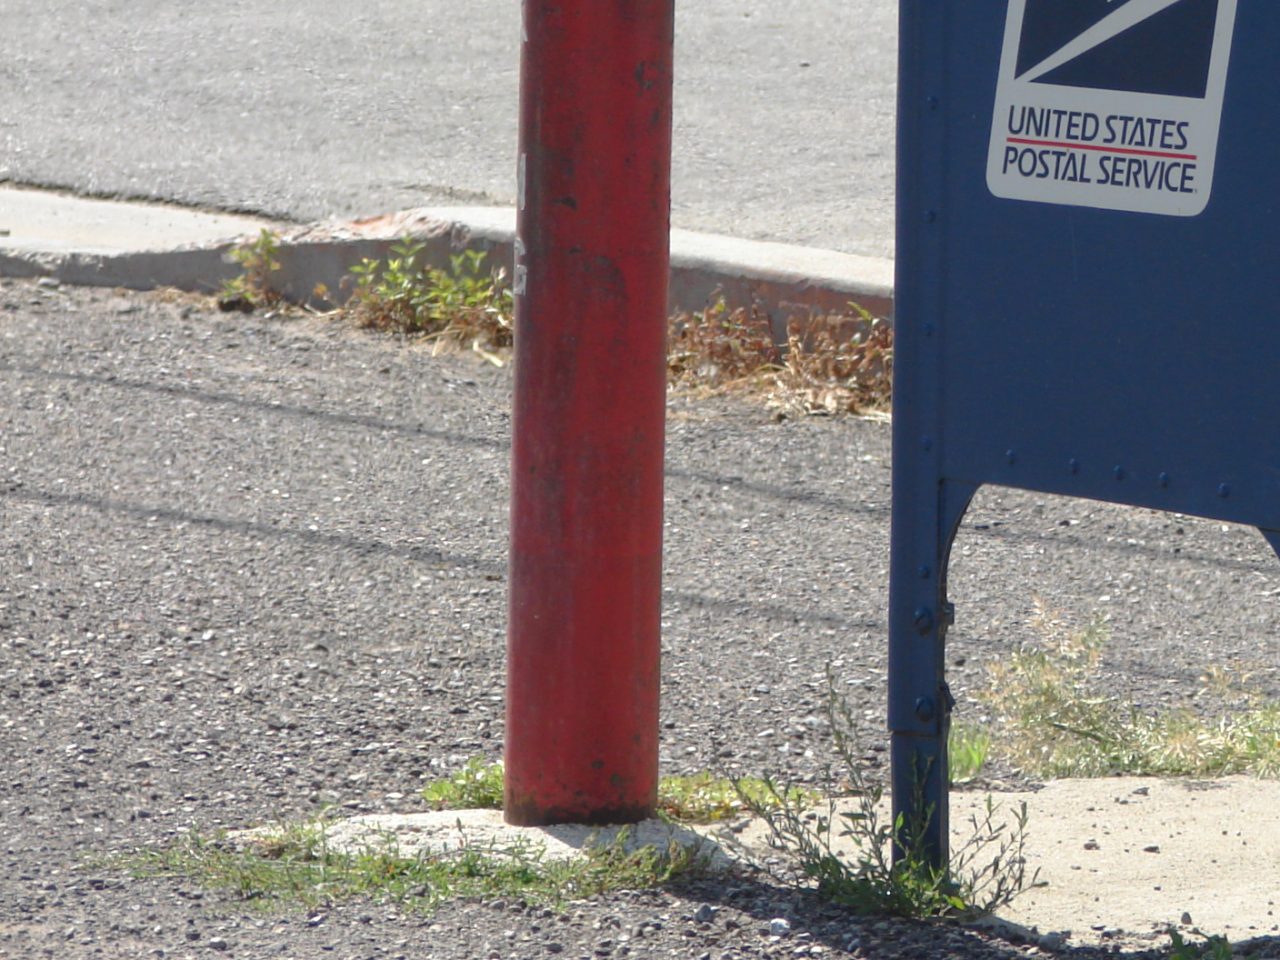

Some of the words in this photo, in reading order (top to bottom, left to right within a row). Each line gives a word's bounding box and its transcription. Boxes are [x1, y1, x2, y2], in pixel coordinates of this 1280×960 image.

[1008, 105, 1099, 141] UNITED
[1103, 114, 1189, 150] STATES
[1002, 146, 1091, 183] POSTAL
